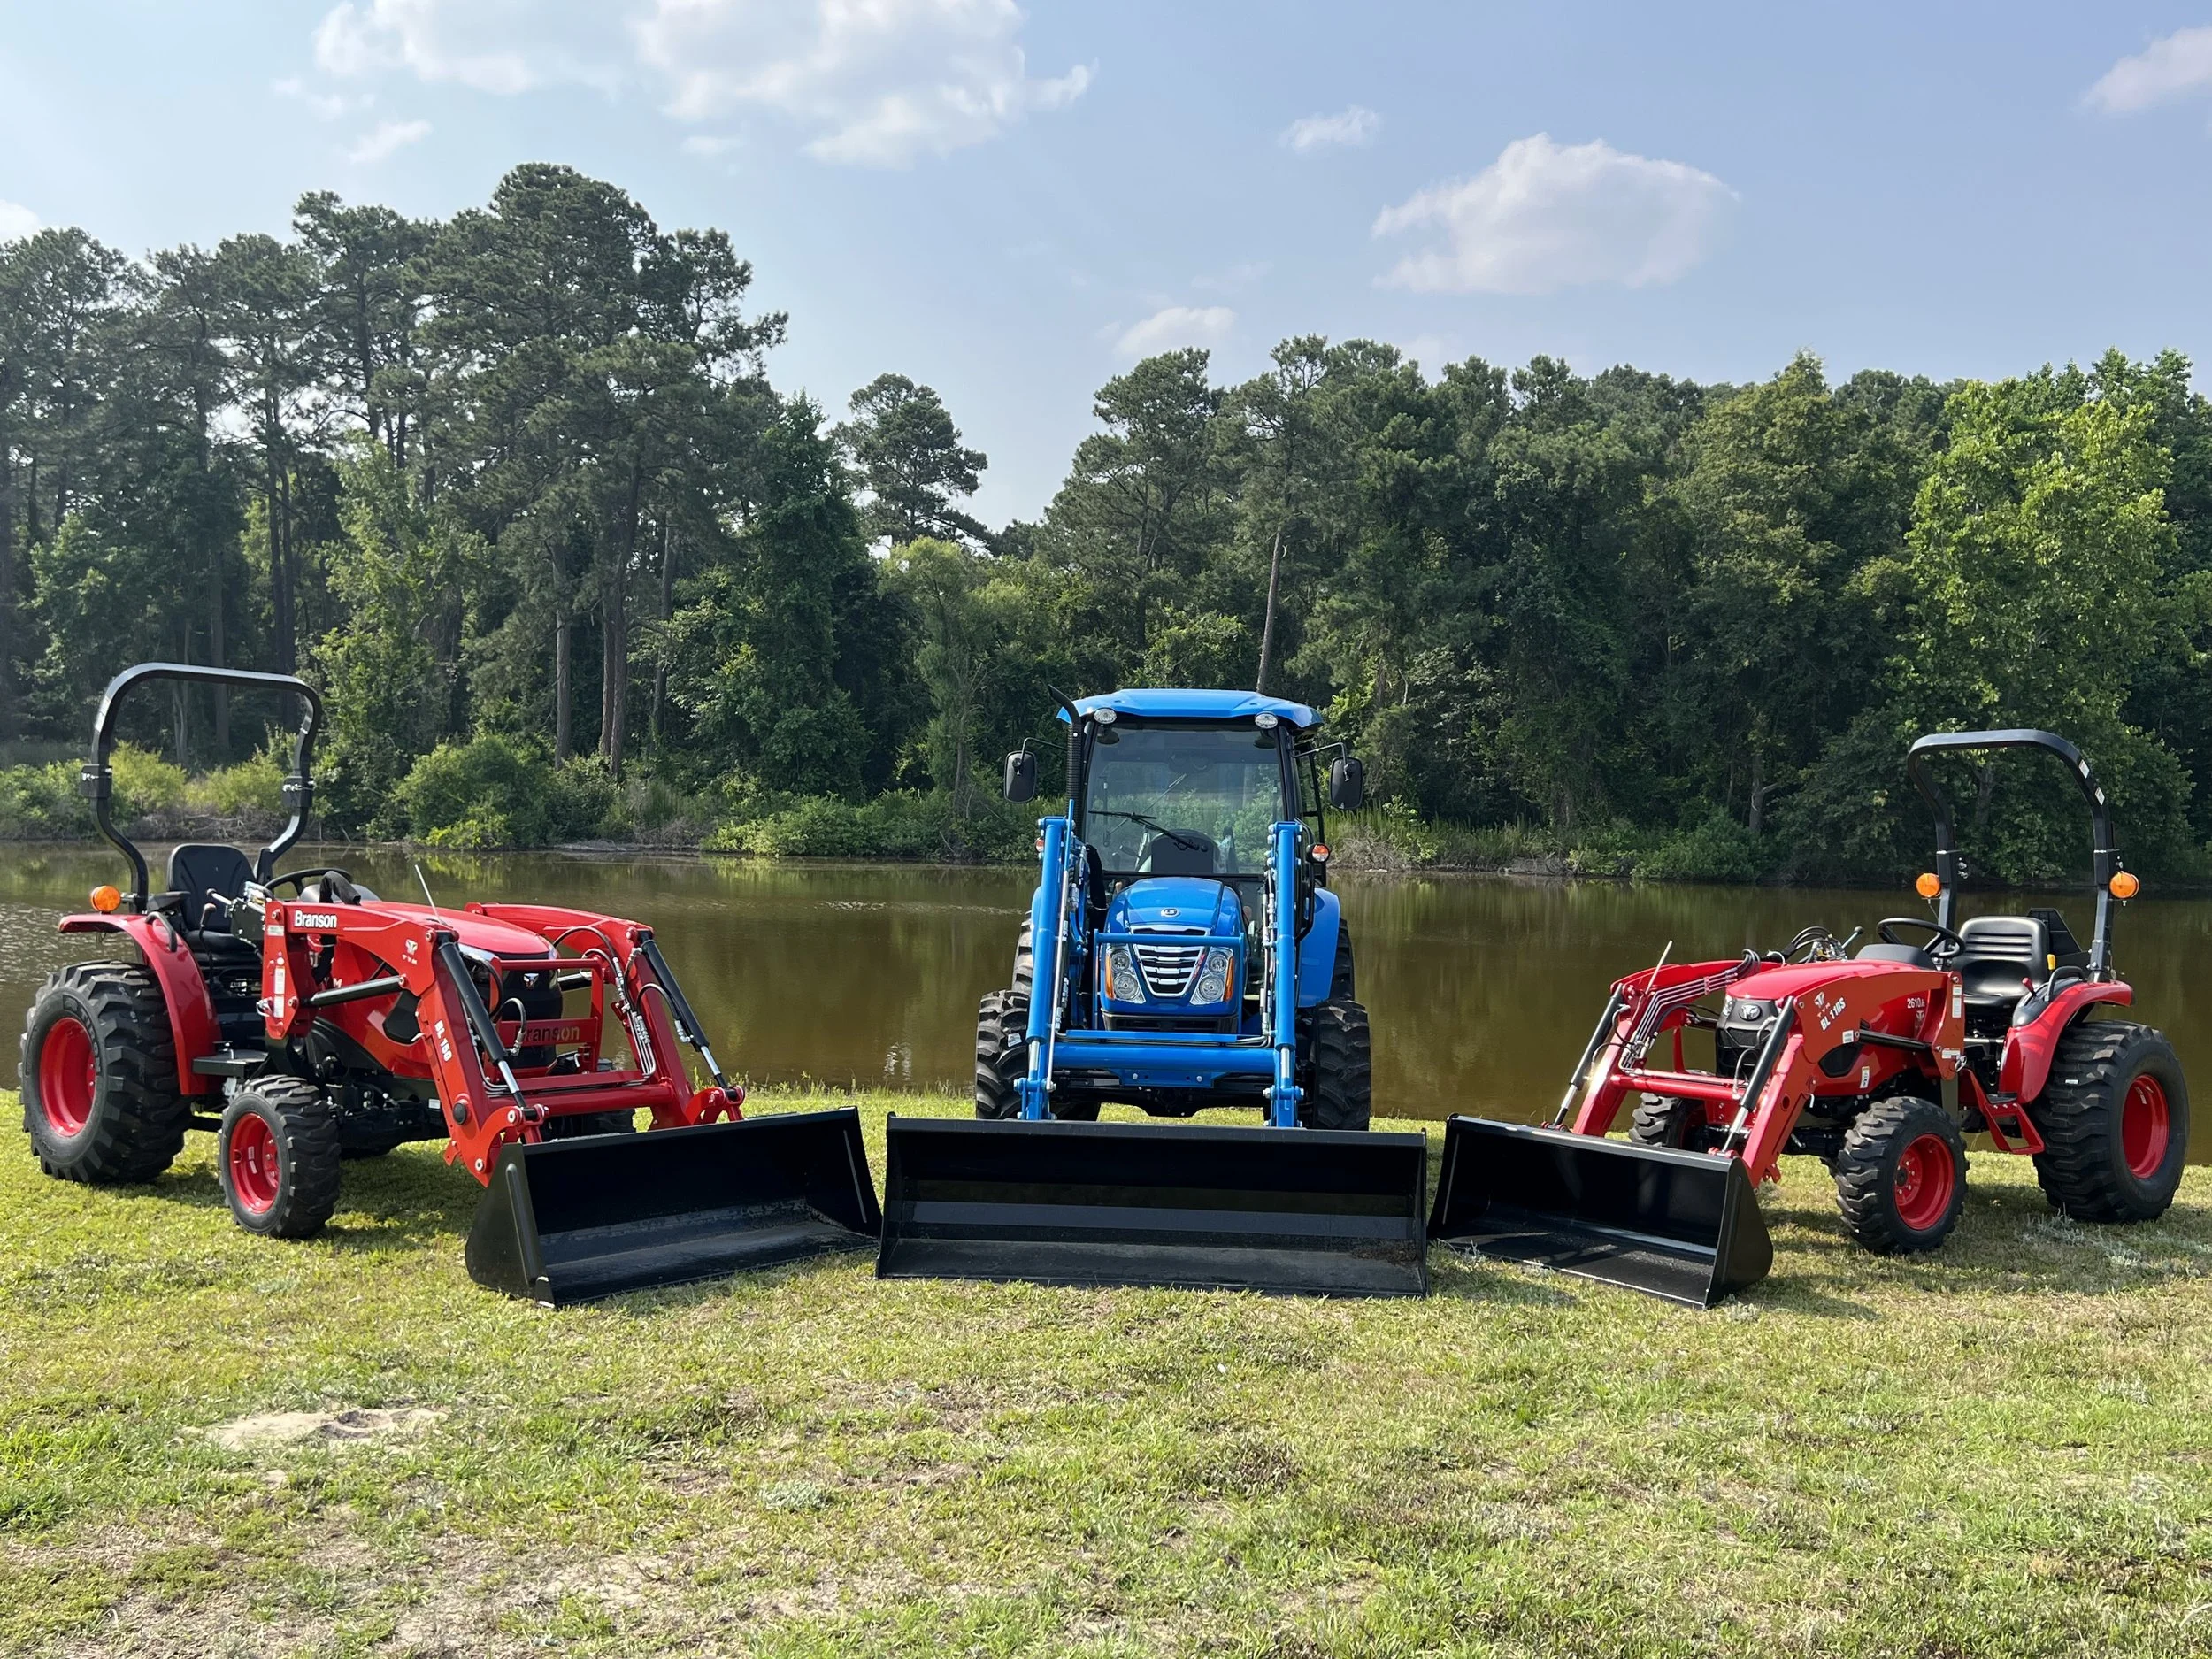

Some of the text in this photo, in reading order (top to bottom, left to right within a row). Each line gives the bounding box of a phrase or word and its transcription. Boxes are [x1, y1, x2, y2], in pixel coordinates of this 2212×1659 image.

[294, 910, 338, 928] Branson
[1820, 997, 1846, 1031] BL 110S
[434, 1020, 452, 1062] BL 150
